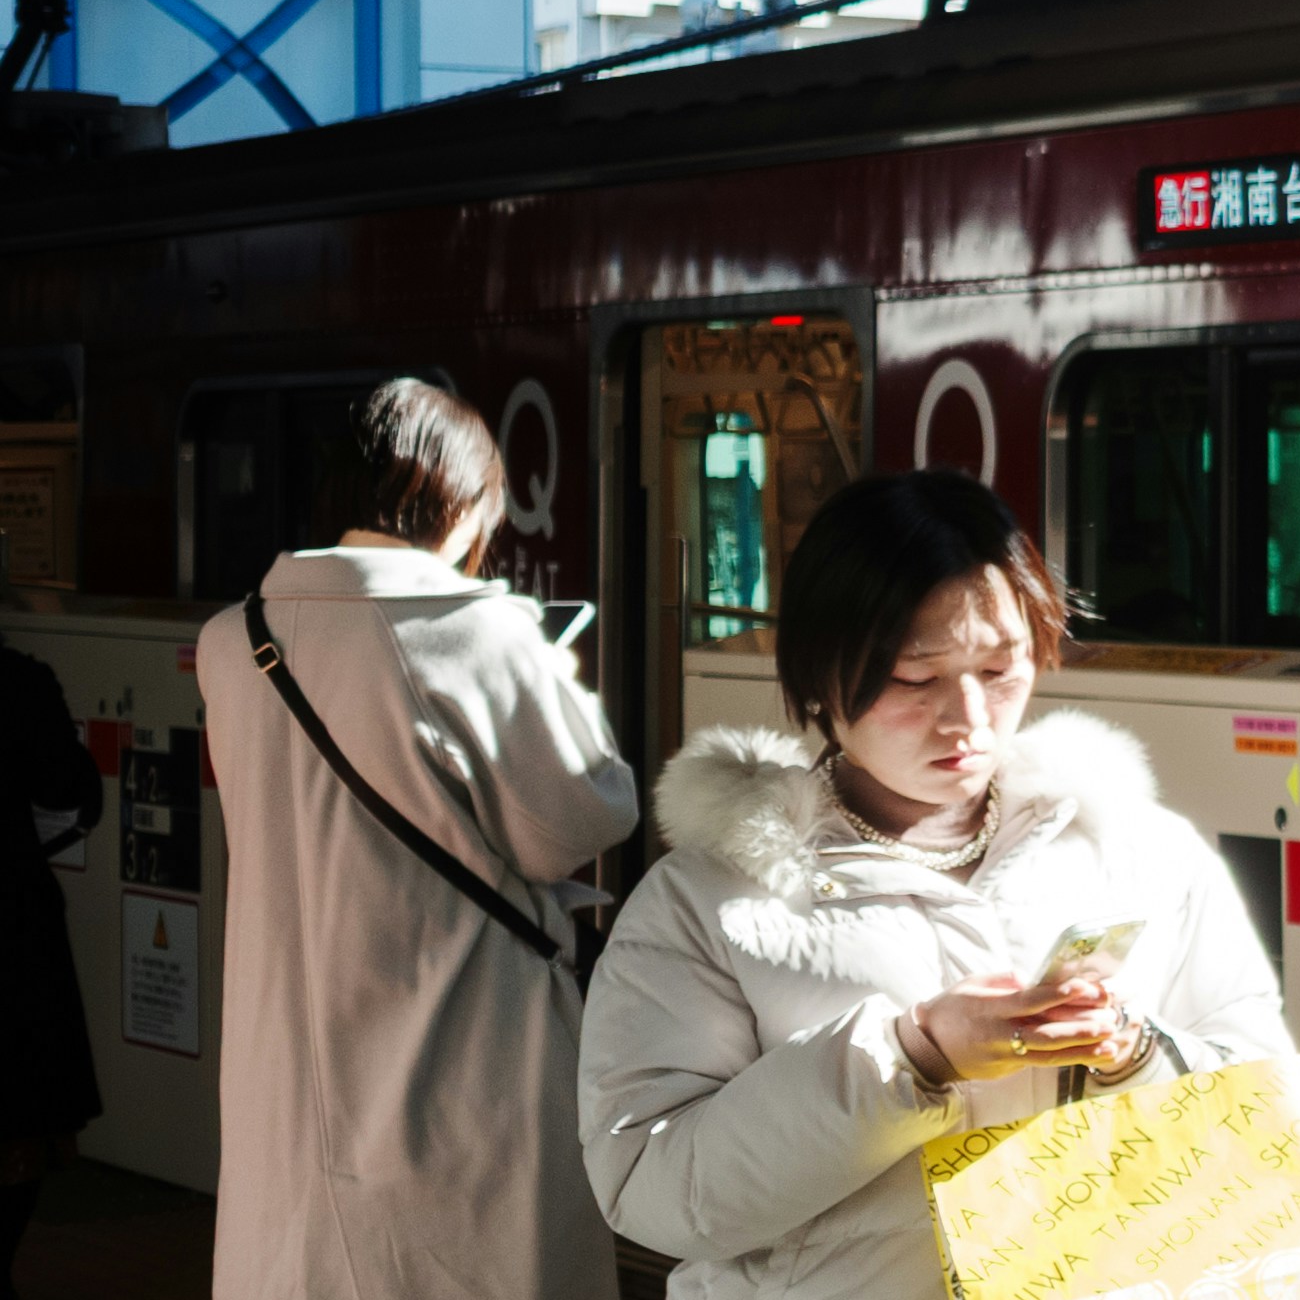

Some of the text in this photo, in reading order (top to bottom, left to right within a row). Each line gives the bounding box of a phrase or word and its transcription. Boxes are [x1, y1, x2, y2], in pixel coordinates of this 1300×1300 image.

[1157, 176, 1207, 228] 急行
[501, 379, 558, 541] Q
[929, 1119, 1021, 1182] SHON
[1032, 1126, 1155, 1232] SHONAN
[1091, 1146, 1216, 1241] TANIWA
[1135, 1173, 1255, 1274] SHONAN
